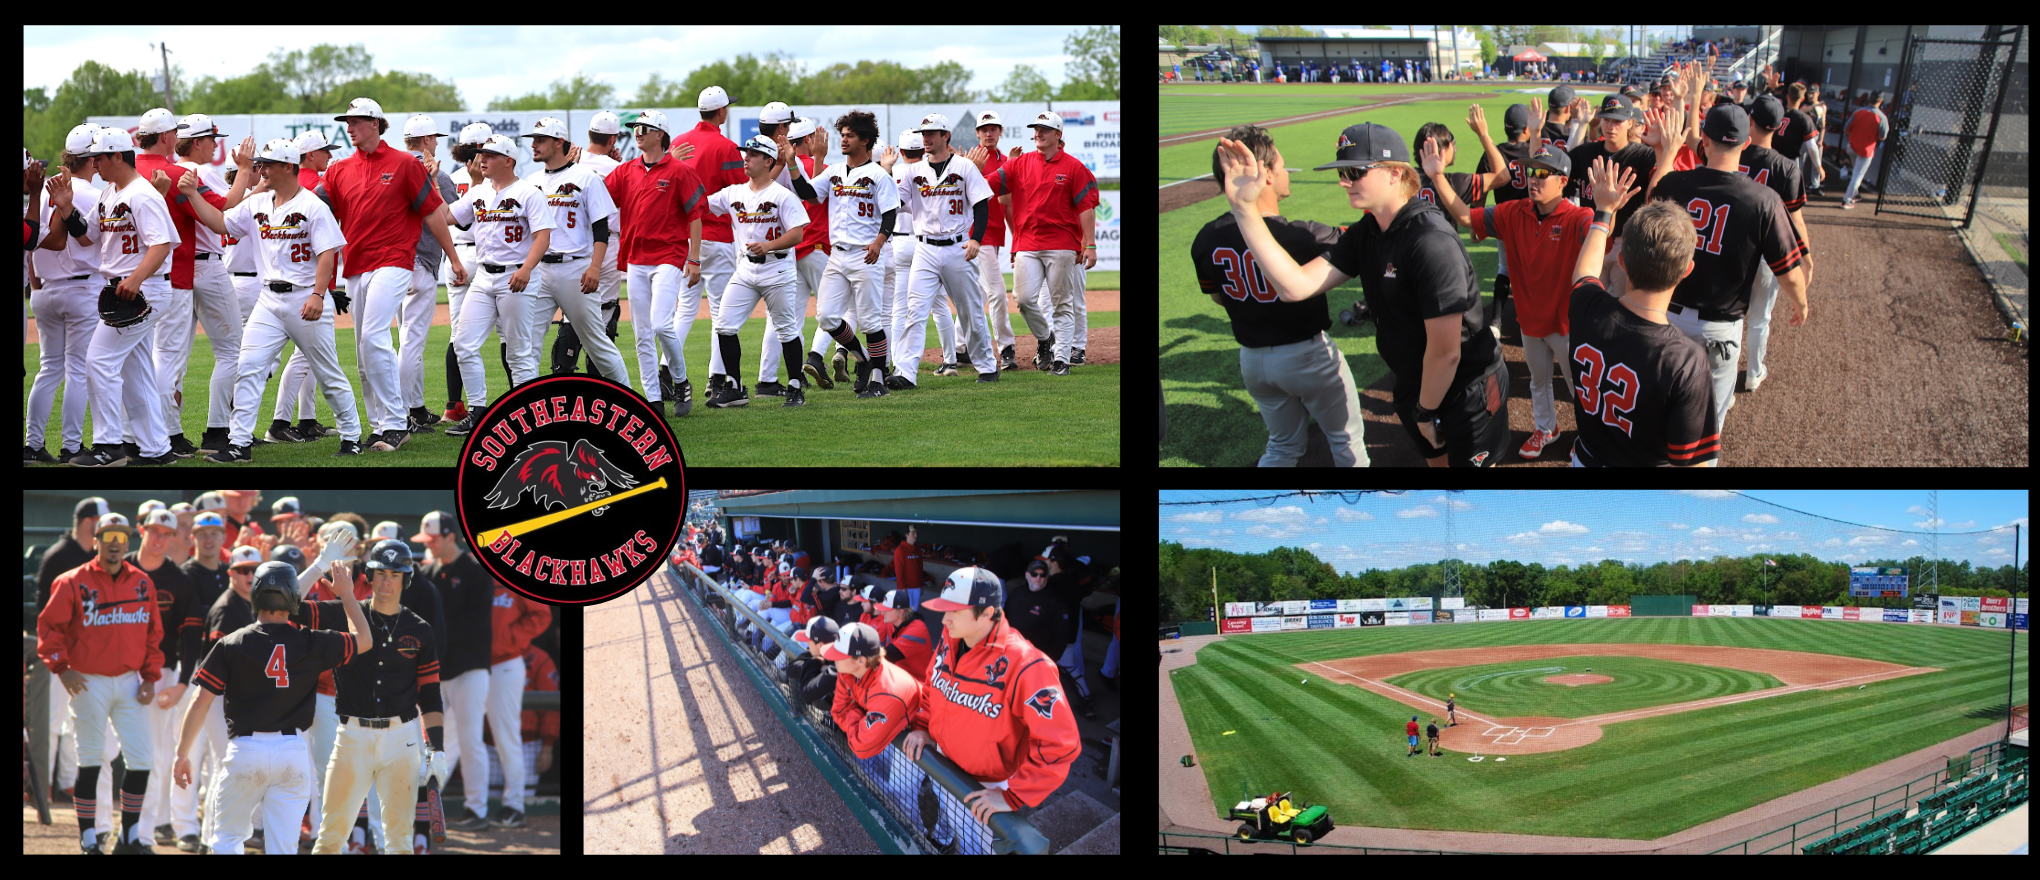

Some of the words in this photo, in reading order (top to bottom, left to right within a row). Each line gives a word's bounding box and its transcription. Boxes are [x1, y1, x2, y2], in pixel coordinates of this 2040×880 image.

[858, 202, 874, 218] 99
[949, 200, 963, 215] 30
[567, 211, 576, 229] 5
[1692, 198, 1731, 256] 21
[260, 224, 308, 240] Blackhawks
[505, 225, 523, 243] 58
[765, 227, 782, 242] 46
[122, 235, 139, 254] 21
[291, 243, 311, 263] 25
[1212, 247, 1279, 303] 30
[1573, 343, 1640, 439] 32
[82, 600, 150, 627] Blackhawks
[265, 644, 289, 688] 4
